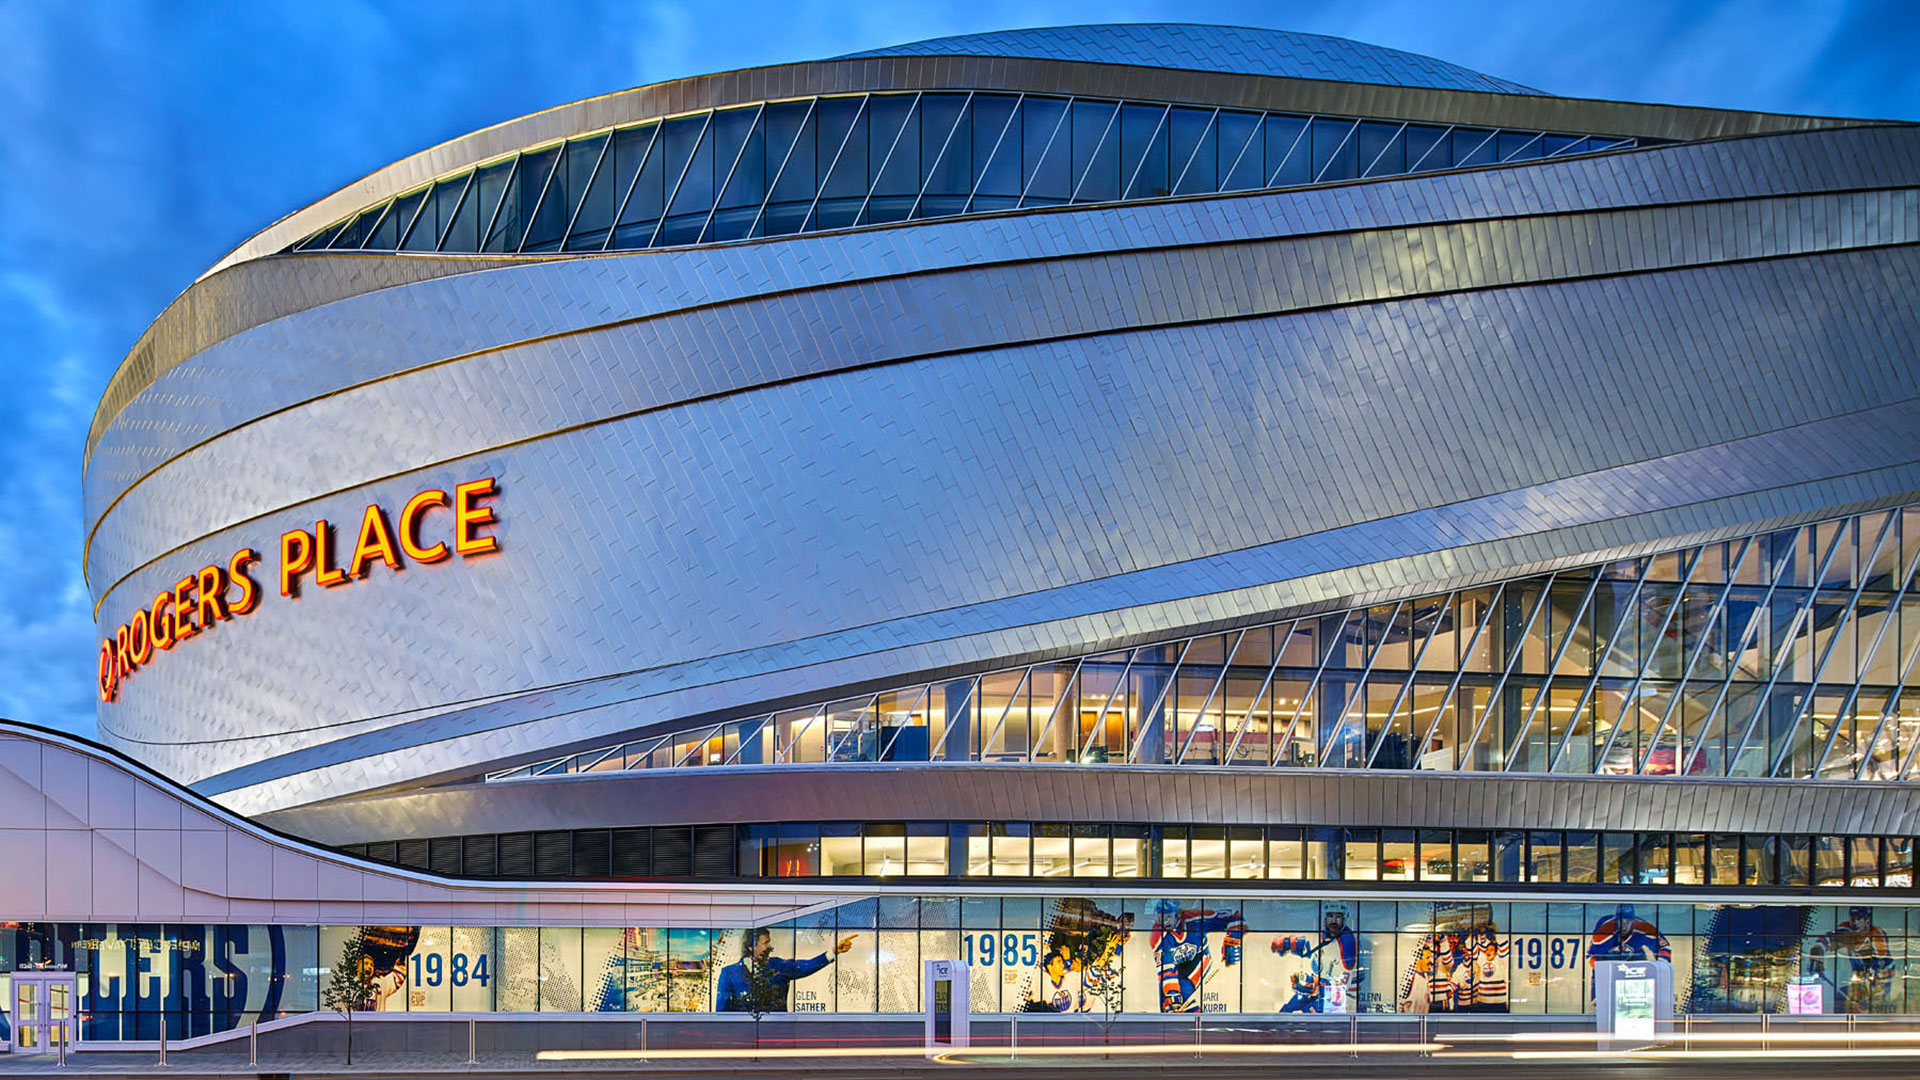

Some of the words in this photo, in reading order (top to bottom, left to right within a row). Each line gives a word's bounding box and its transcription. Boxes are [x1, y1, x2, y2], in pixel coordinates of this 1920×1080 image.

[116, 548, 261, 681] ROGERS
[280, 477, 498, 597] PLACE
[964, 934, 1037, 966] 1985
[1514, 937, 1580, 969] 1987
[411, 953, 490, 987] 1984
[411, 995, 425, 1004] CUP
[796, 990, 817, 1001] GLEN
[1203, 992, 1219, 1002] JARI
[1359, 992, 1382, 1002] GLENN
[796, 1002, 826, 1012] SATHER
[1203, 1003, 1227, 1013] KURRI
